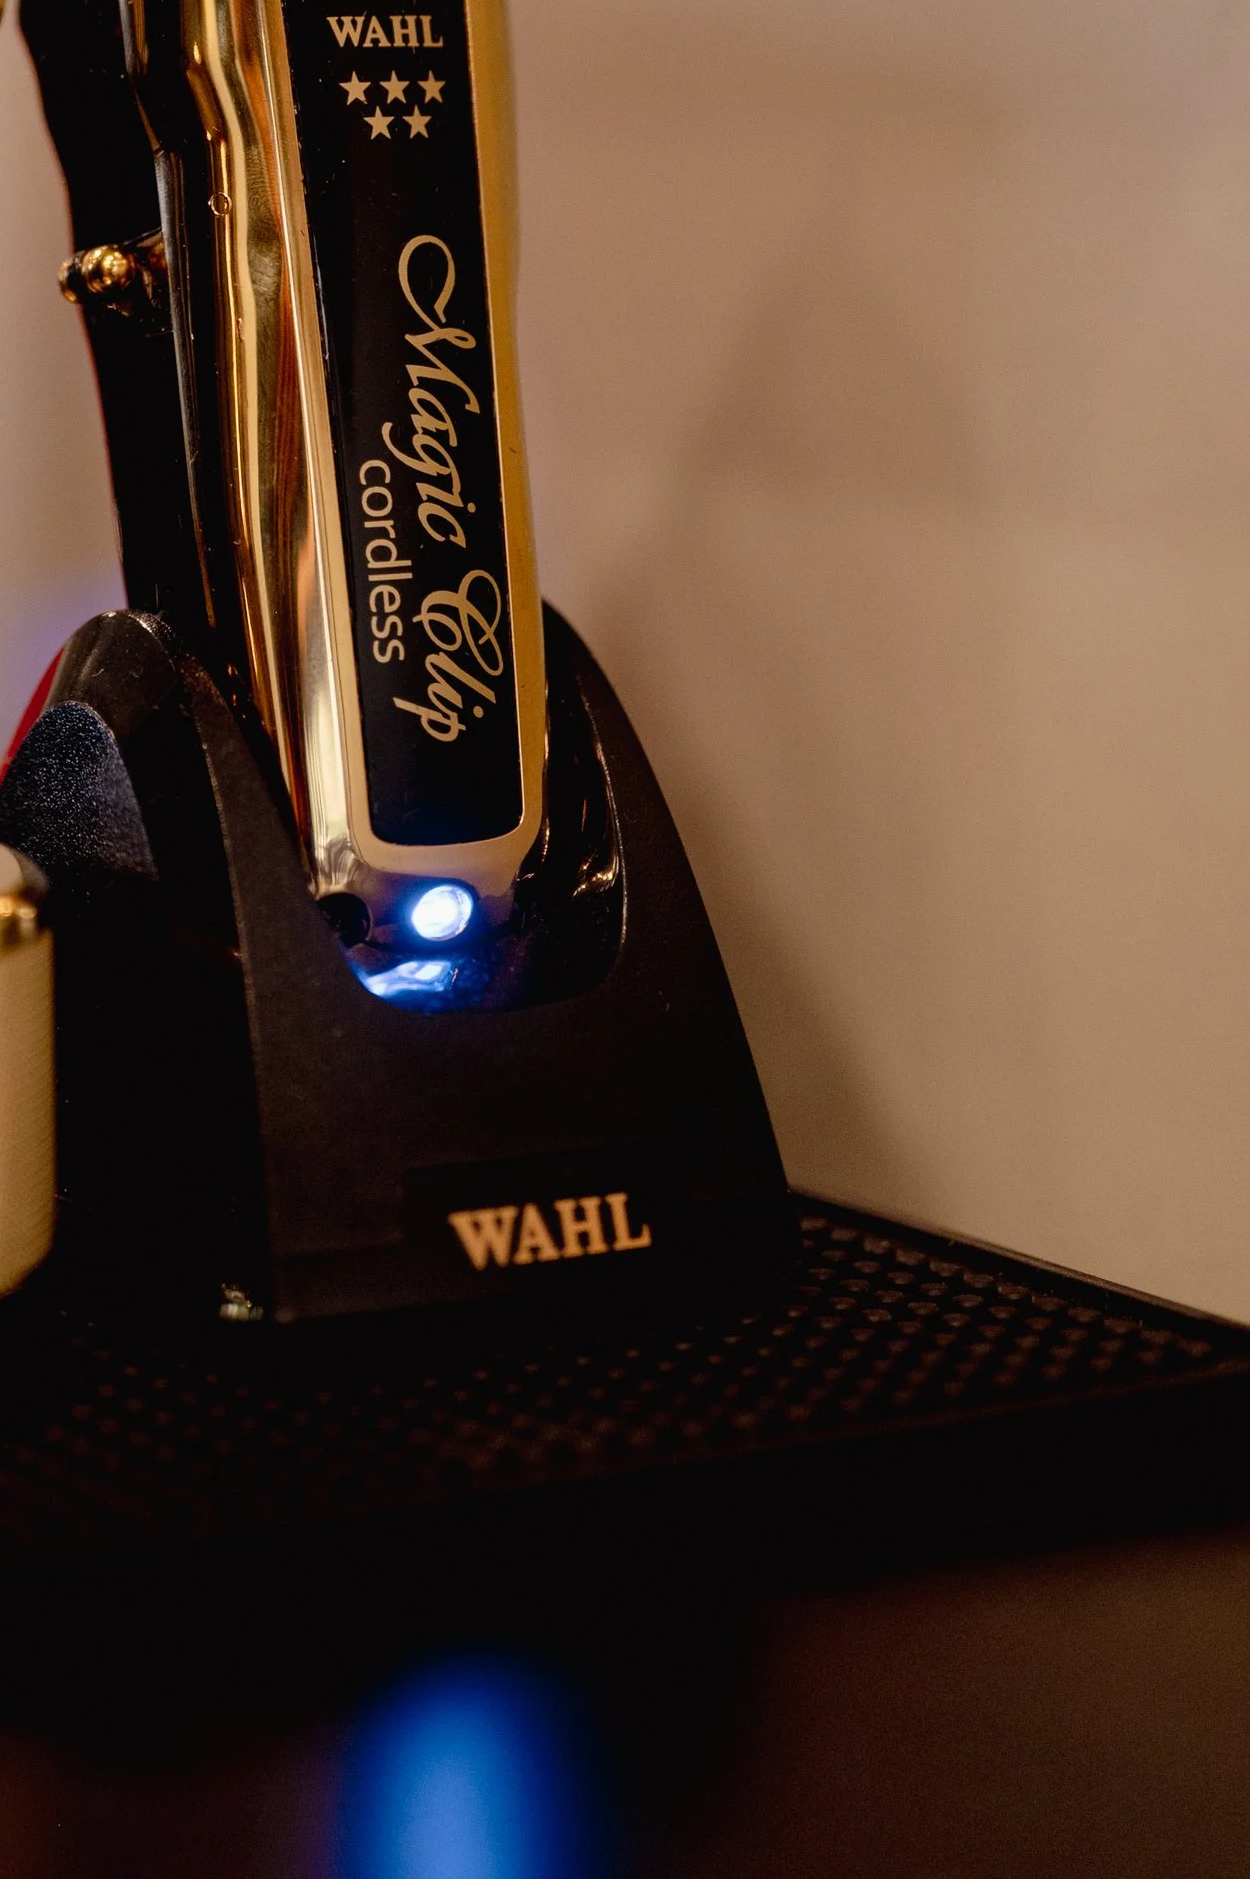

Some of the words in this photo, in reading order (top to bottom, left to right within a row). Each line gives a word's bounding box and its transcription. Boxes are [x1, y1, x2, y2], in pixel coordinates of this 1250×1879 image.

[326, 14, 444, 48] WAHL
[381, 234, 481, 550] Magic
[358, 458, 413, 665] cordless
[393, 568, 504, 743] Clip
[448, 1192, 652, 1271] WAHL
